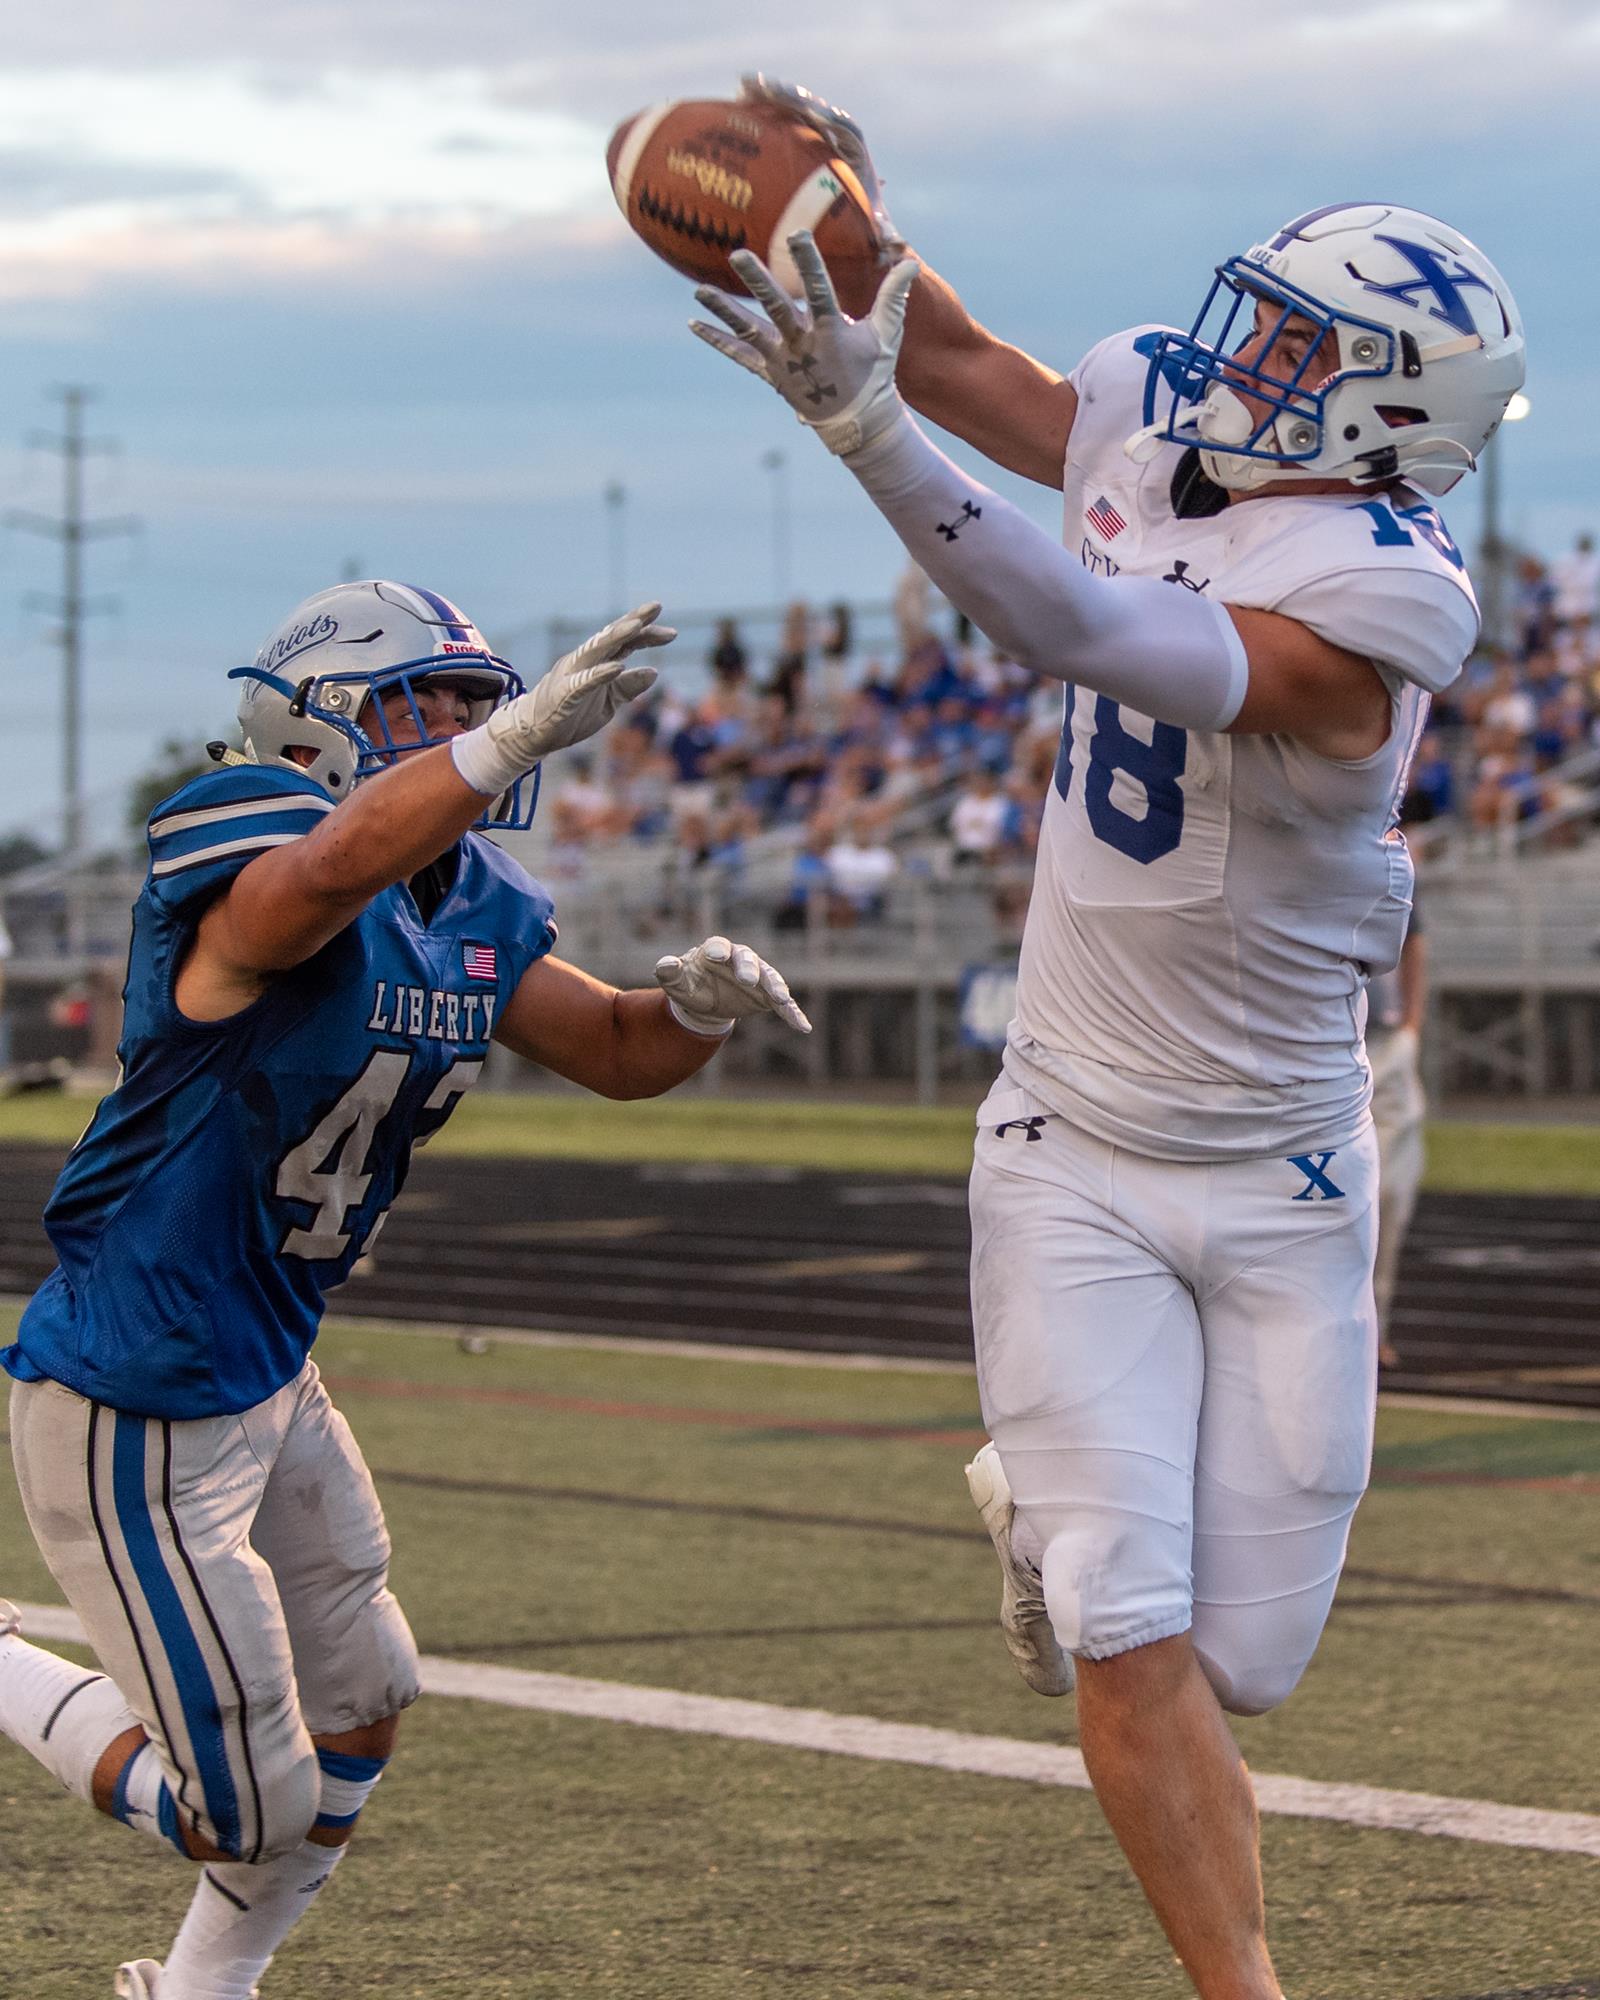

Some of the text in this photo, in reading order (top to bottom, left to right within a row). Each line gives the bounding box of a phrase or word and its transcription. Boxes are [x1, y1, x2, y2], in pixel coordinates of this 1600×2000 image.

[1363, 234, 1495, 337] X
[1346, 502, 1464, 571] 18
[250, 614, 338, 676] atriots
[368, 982, 497, 1041] LIBERTY
[1286, 1151, 1346, 1200] X
